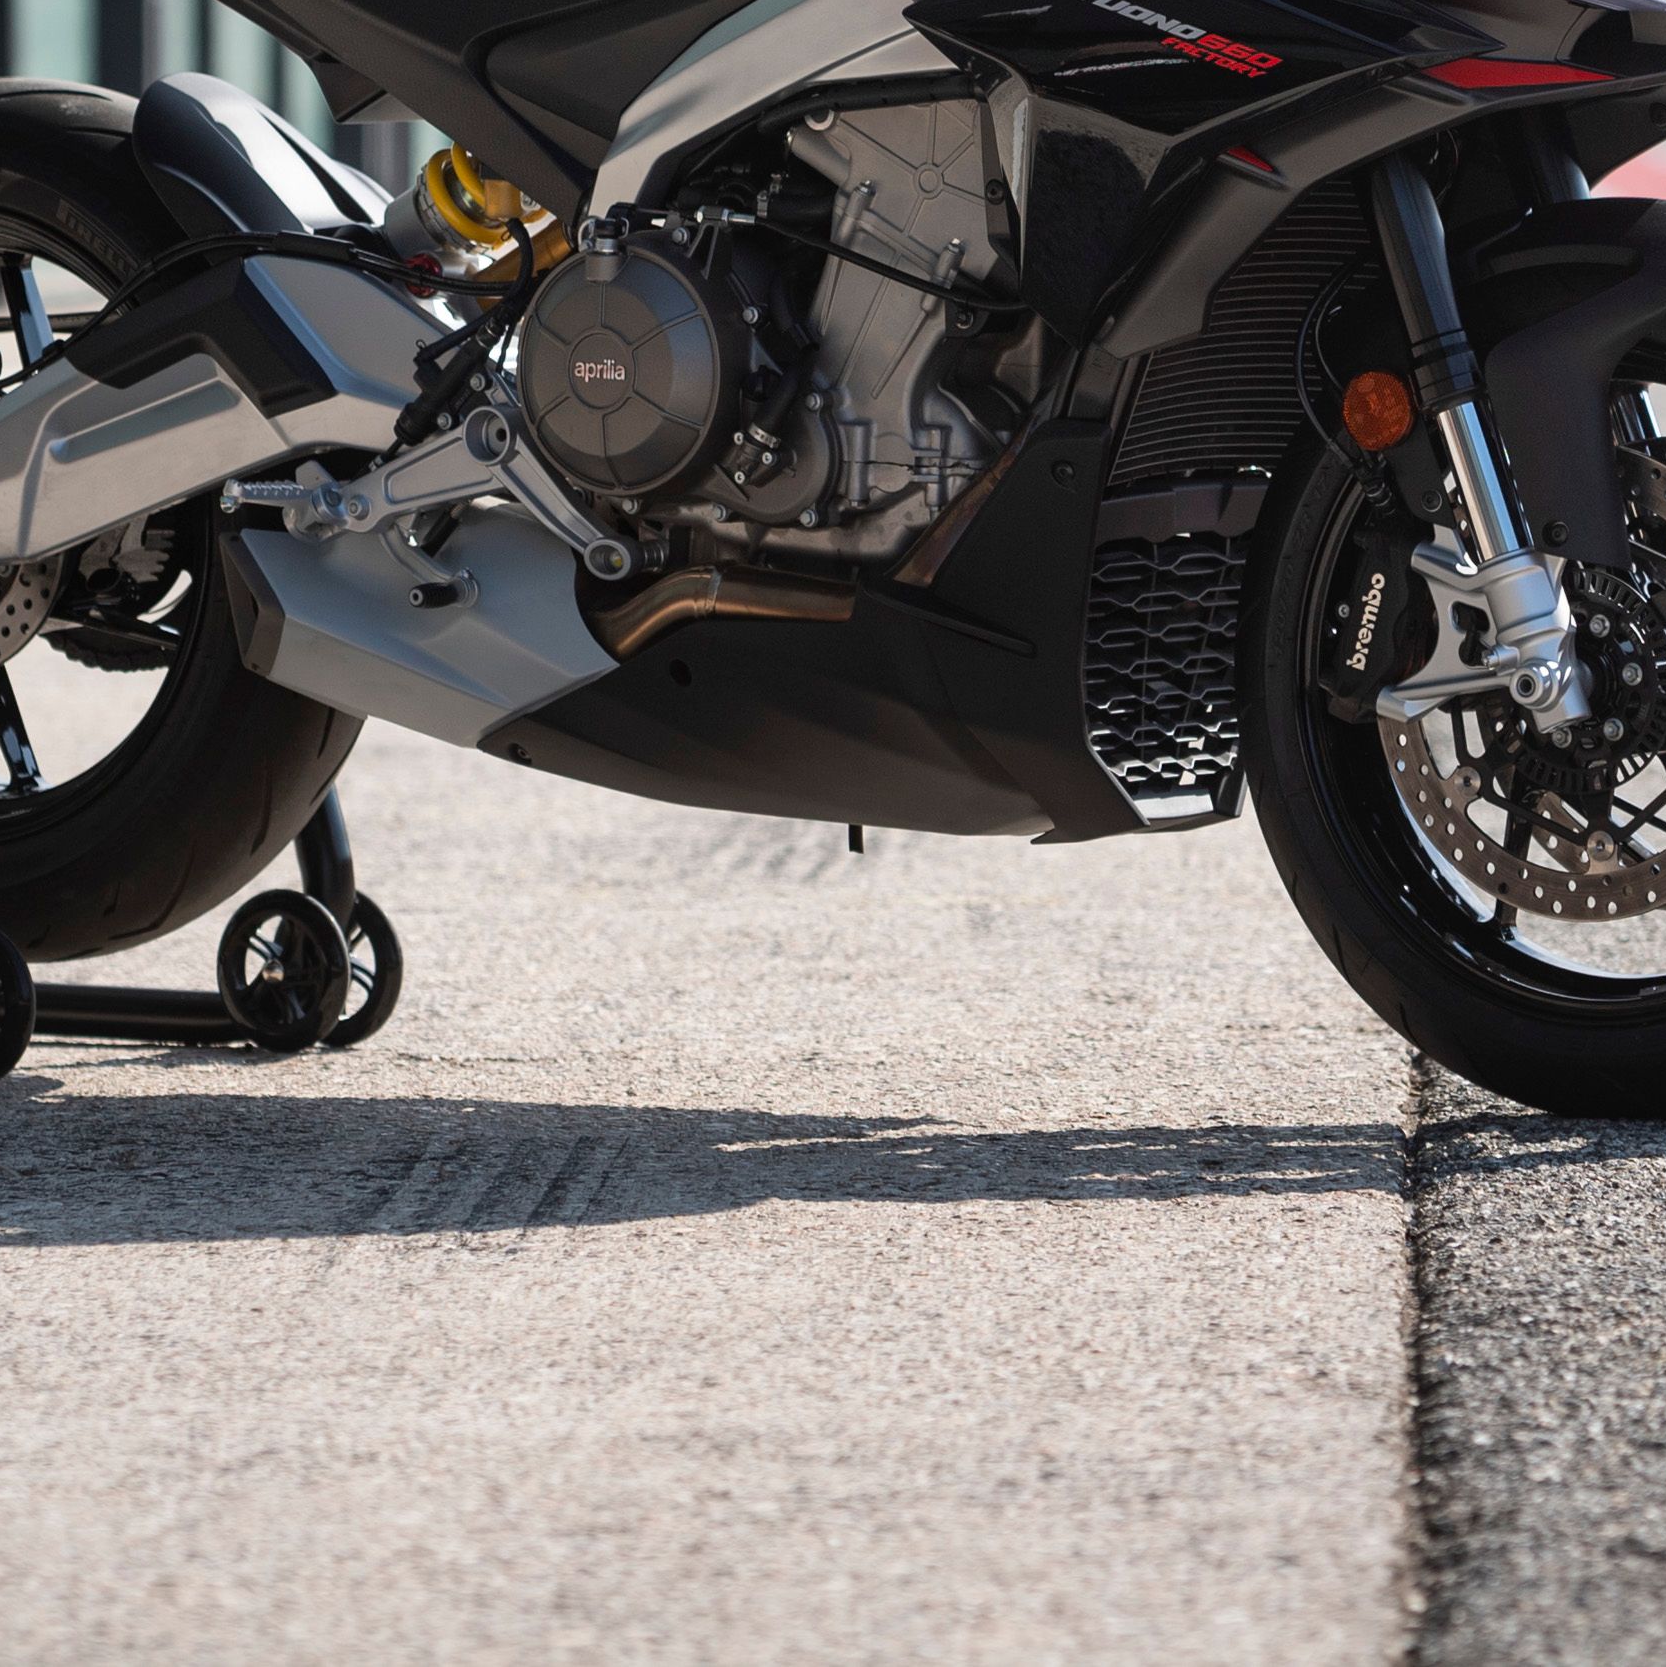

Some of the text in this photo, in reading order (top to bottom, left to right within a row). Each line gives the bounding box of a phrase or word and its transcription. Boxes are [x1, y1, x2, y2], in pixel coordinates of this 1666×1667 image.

[1161, 37, 1268, 78] FACTORY
[574, 358, 626, 383] aprilia
[1346, 572, 1385, 671] brembo
